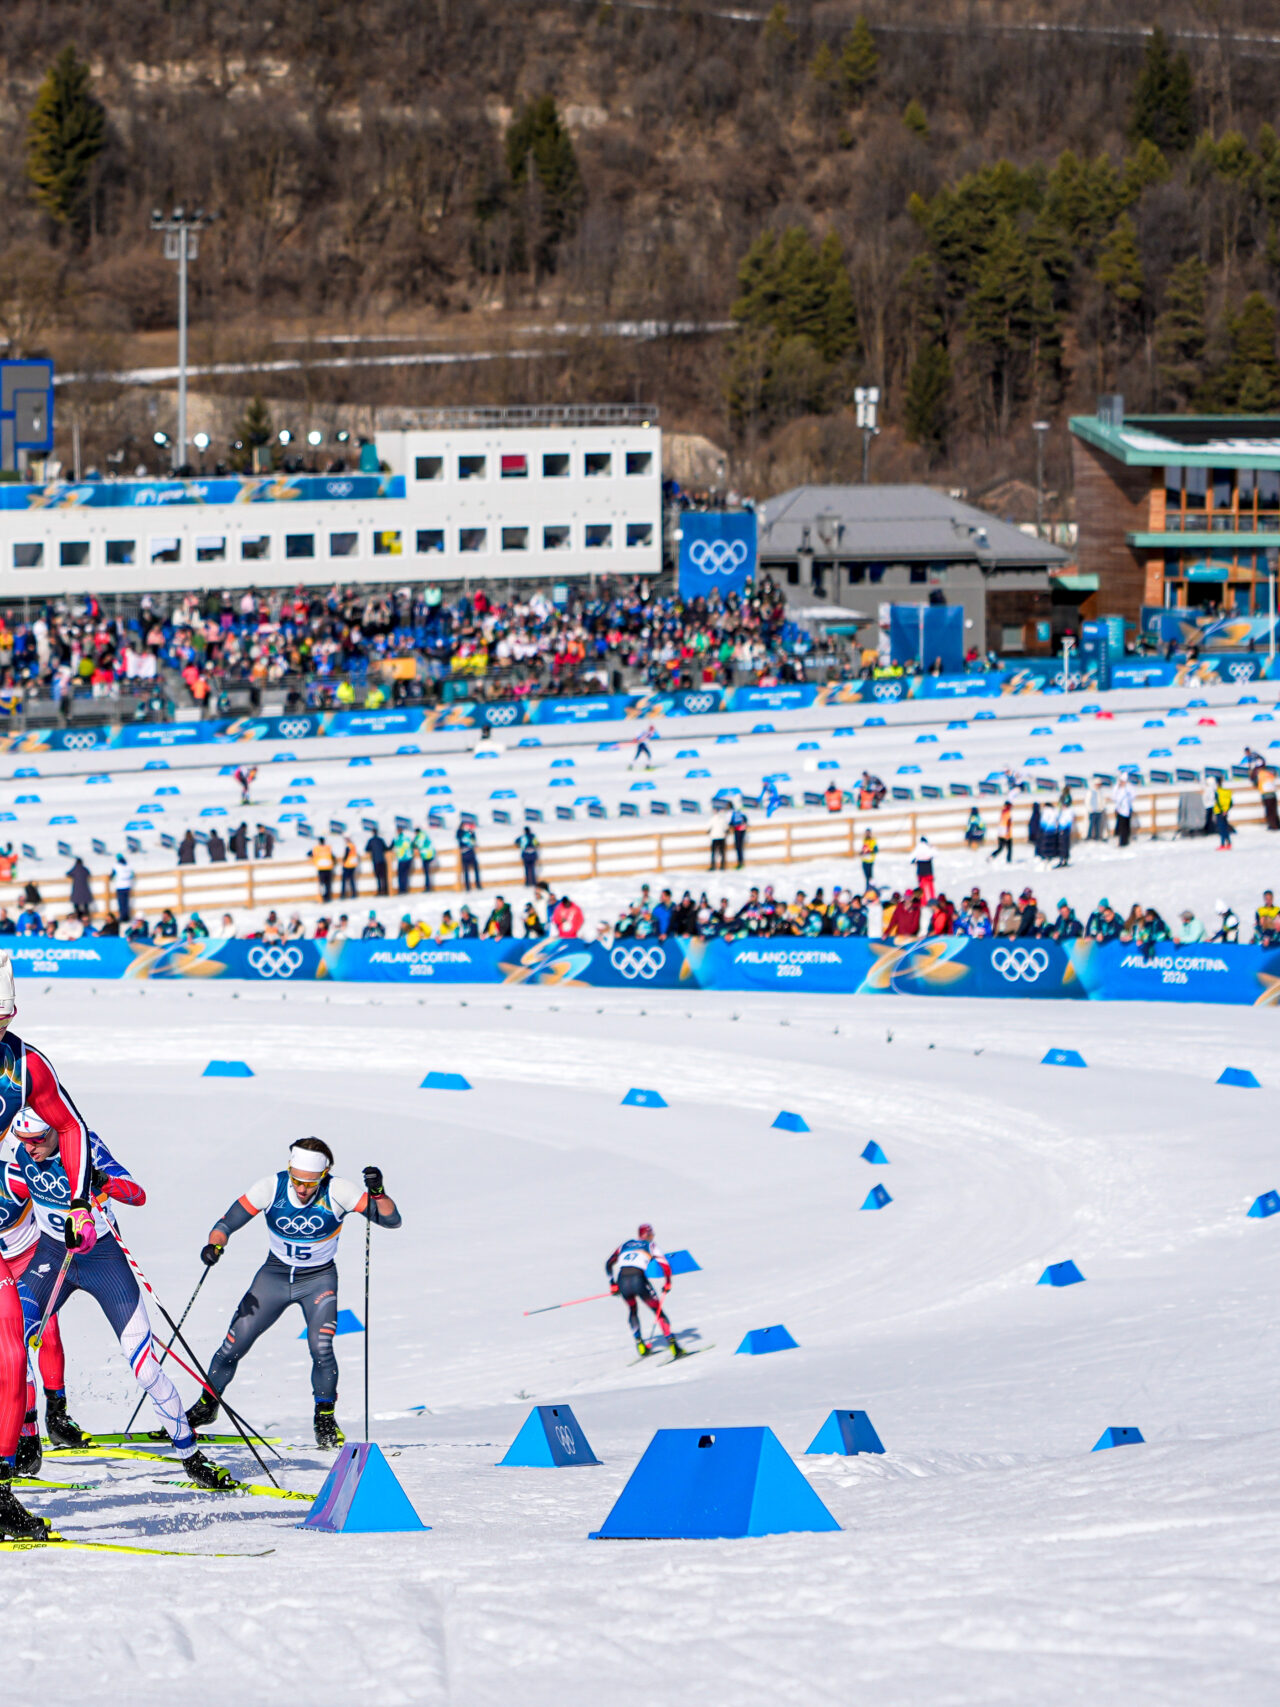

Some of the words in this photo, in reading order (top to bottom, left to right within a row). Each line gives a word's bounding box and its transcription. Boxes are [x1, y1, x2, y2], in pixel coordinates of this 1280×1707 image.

[45, 949, 102, 961] CORTINA
[369, 951, 419, 963] MILANO
[420, 951, 472, 963] CORTINA
[735, 951, 787, 964] MILANO
[788, 951, 842, 964] CORTINA
[777, 964, 802, 977] 2026
[1174, 956, 1229, 972] CORTINA
[1162, 970, 1188, 984] 2026
[47, 1213, 66, 1233] 9
[283, 1241, 312, 1260] 15
